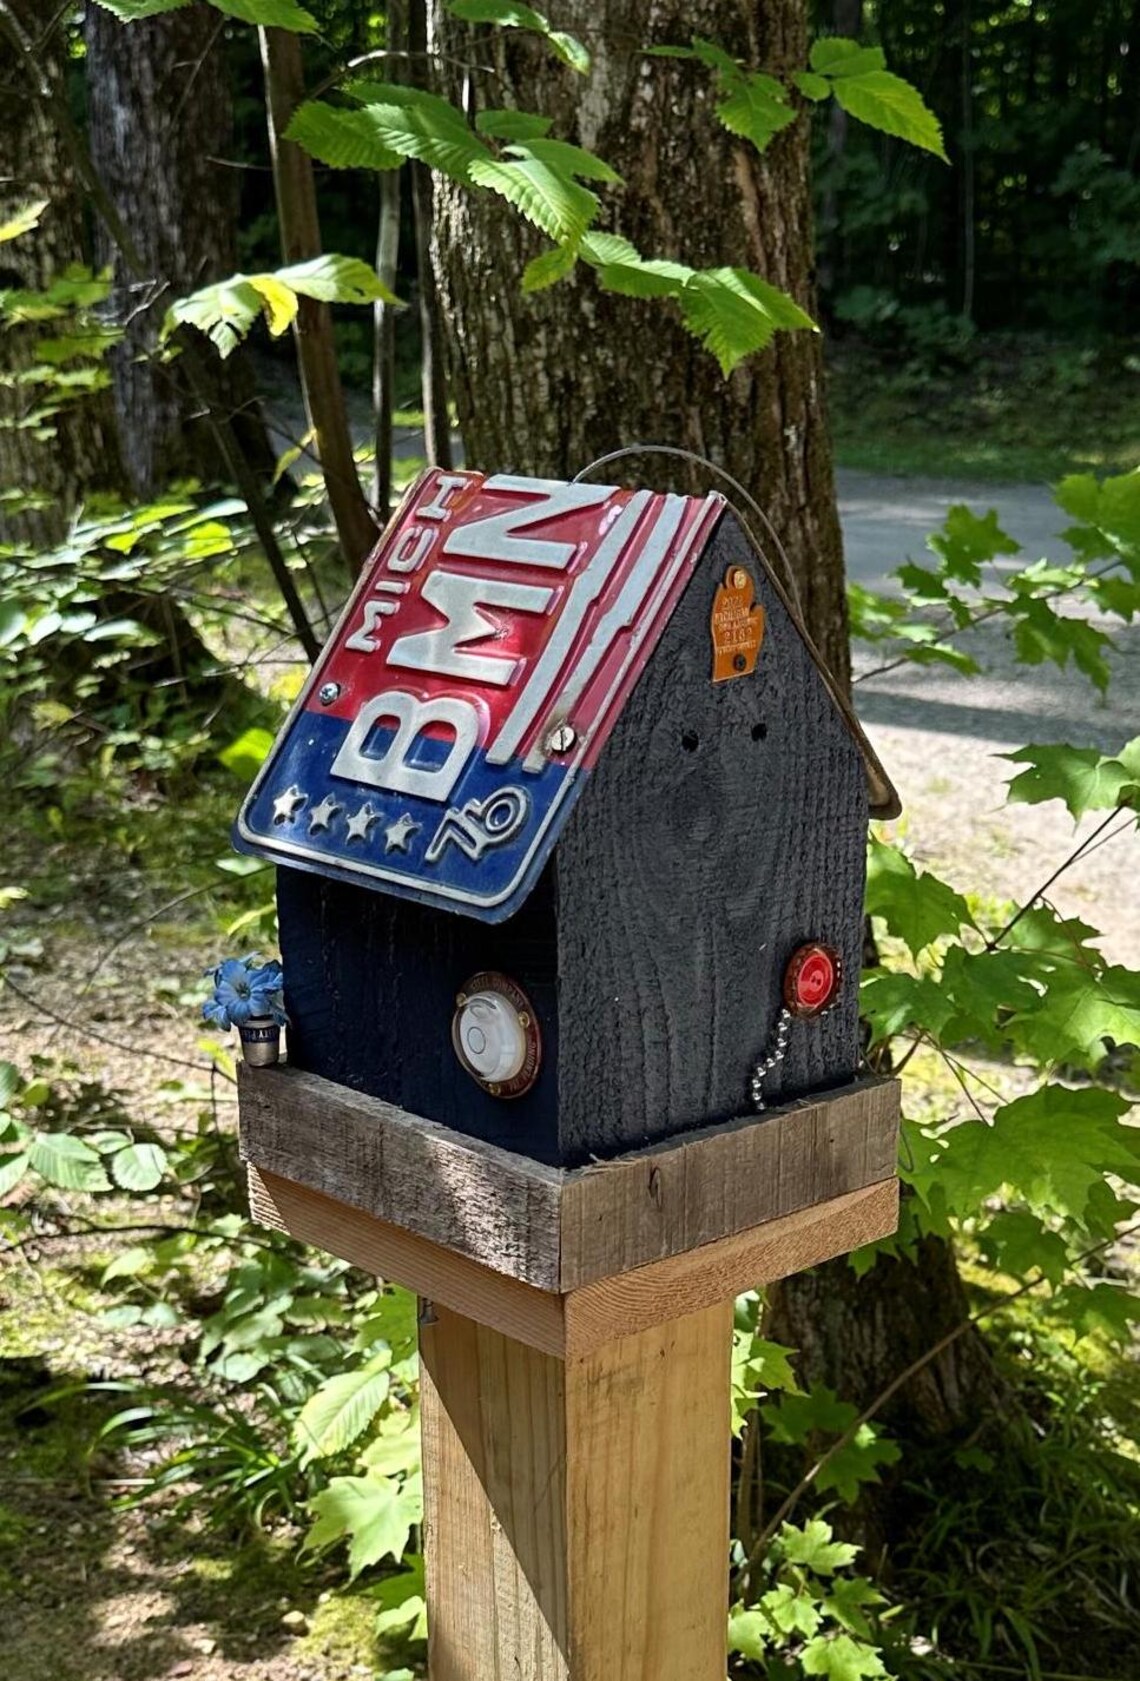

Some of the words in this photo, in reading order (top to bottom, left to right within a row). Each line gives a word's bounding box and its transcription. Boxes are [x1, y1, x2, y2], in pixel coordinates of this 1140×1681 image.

[330, 474, 621, 802] BMN
[346, 476, 469, 651] MICH
[424, 786, 533, 863] 76
